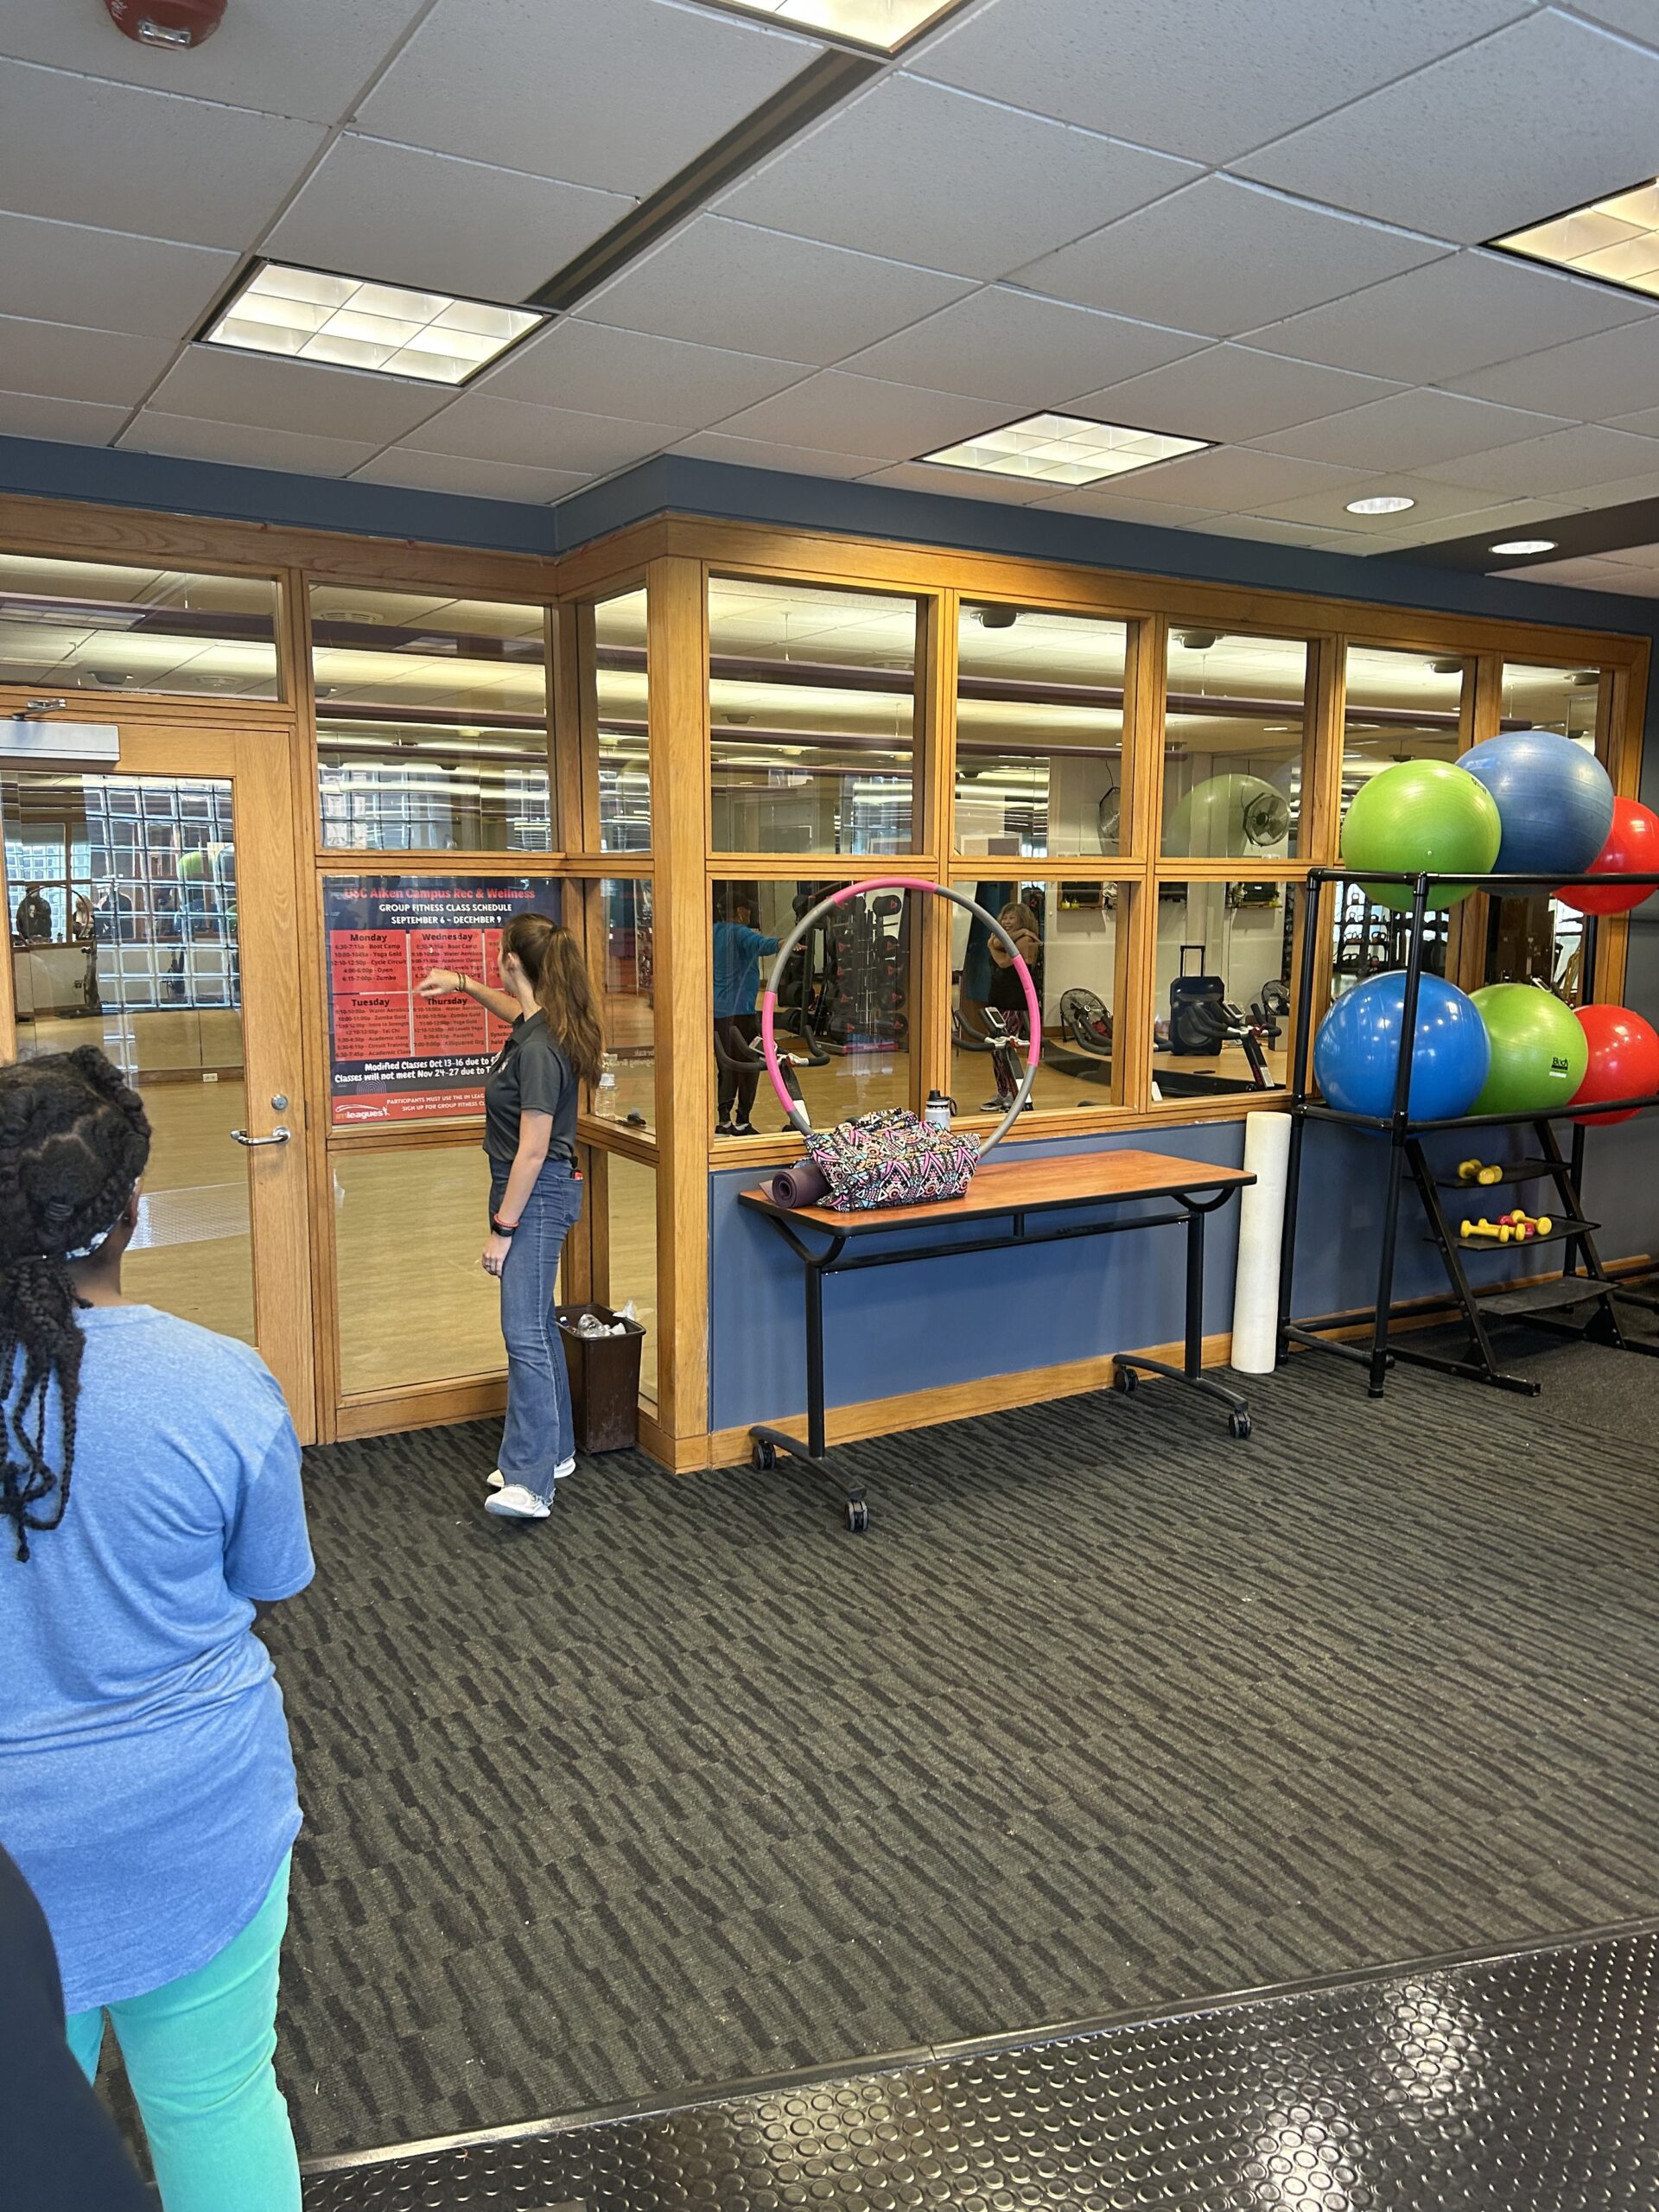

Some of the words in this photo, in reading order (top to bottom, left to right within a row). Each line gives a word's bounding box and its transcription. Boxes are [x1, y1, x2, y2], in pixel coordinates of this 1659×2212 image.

[370, 887, 404, 899] Aiken
[405, 887, 451, 900] Campus
[453, 887, 474, 899] Rec
[475, 888, 484, 899] &
[486, 887, 536, 899] Wellness
[391, 916, 439, 925] SEPTEMBER
[350, 934, 387, 943] Monday
[422, 933, 474, 942] Wednesday
[351, 998, 390, 1007] Tuesday
[428, 997, 468, 1006] Thursday
[365, 1062, 399, 1071] Modified
[401, 1061, 428, 1070] Classes
[429, 1059, 442, 1068] Oct
[443, 1058, 464, 1067] 13-16
[465, 1058, 480, 1066] due
[480, 1057, 490, 1065] to
[334, 1074, 363, 1083] Classes
[364, 1072, 379, 1081] will
[380, 1071, 395, 1080] not
[396, 1071, 416, 1079] meet
[417, 1070, 433, 1078] Nov
[434, 1068, 459, 1077] 24-27
[461, 1067, 475, 1076] due
[476, 1066, 485, 1075] to
